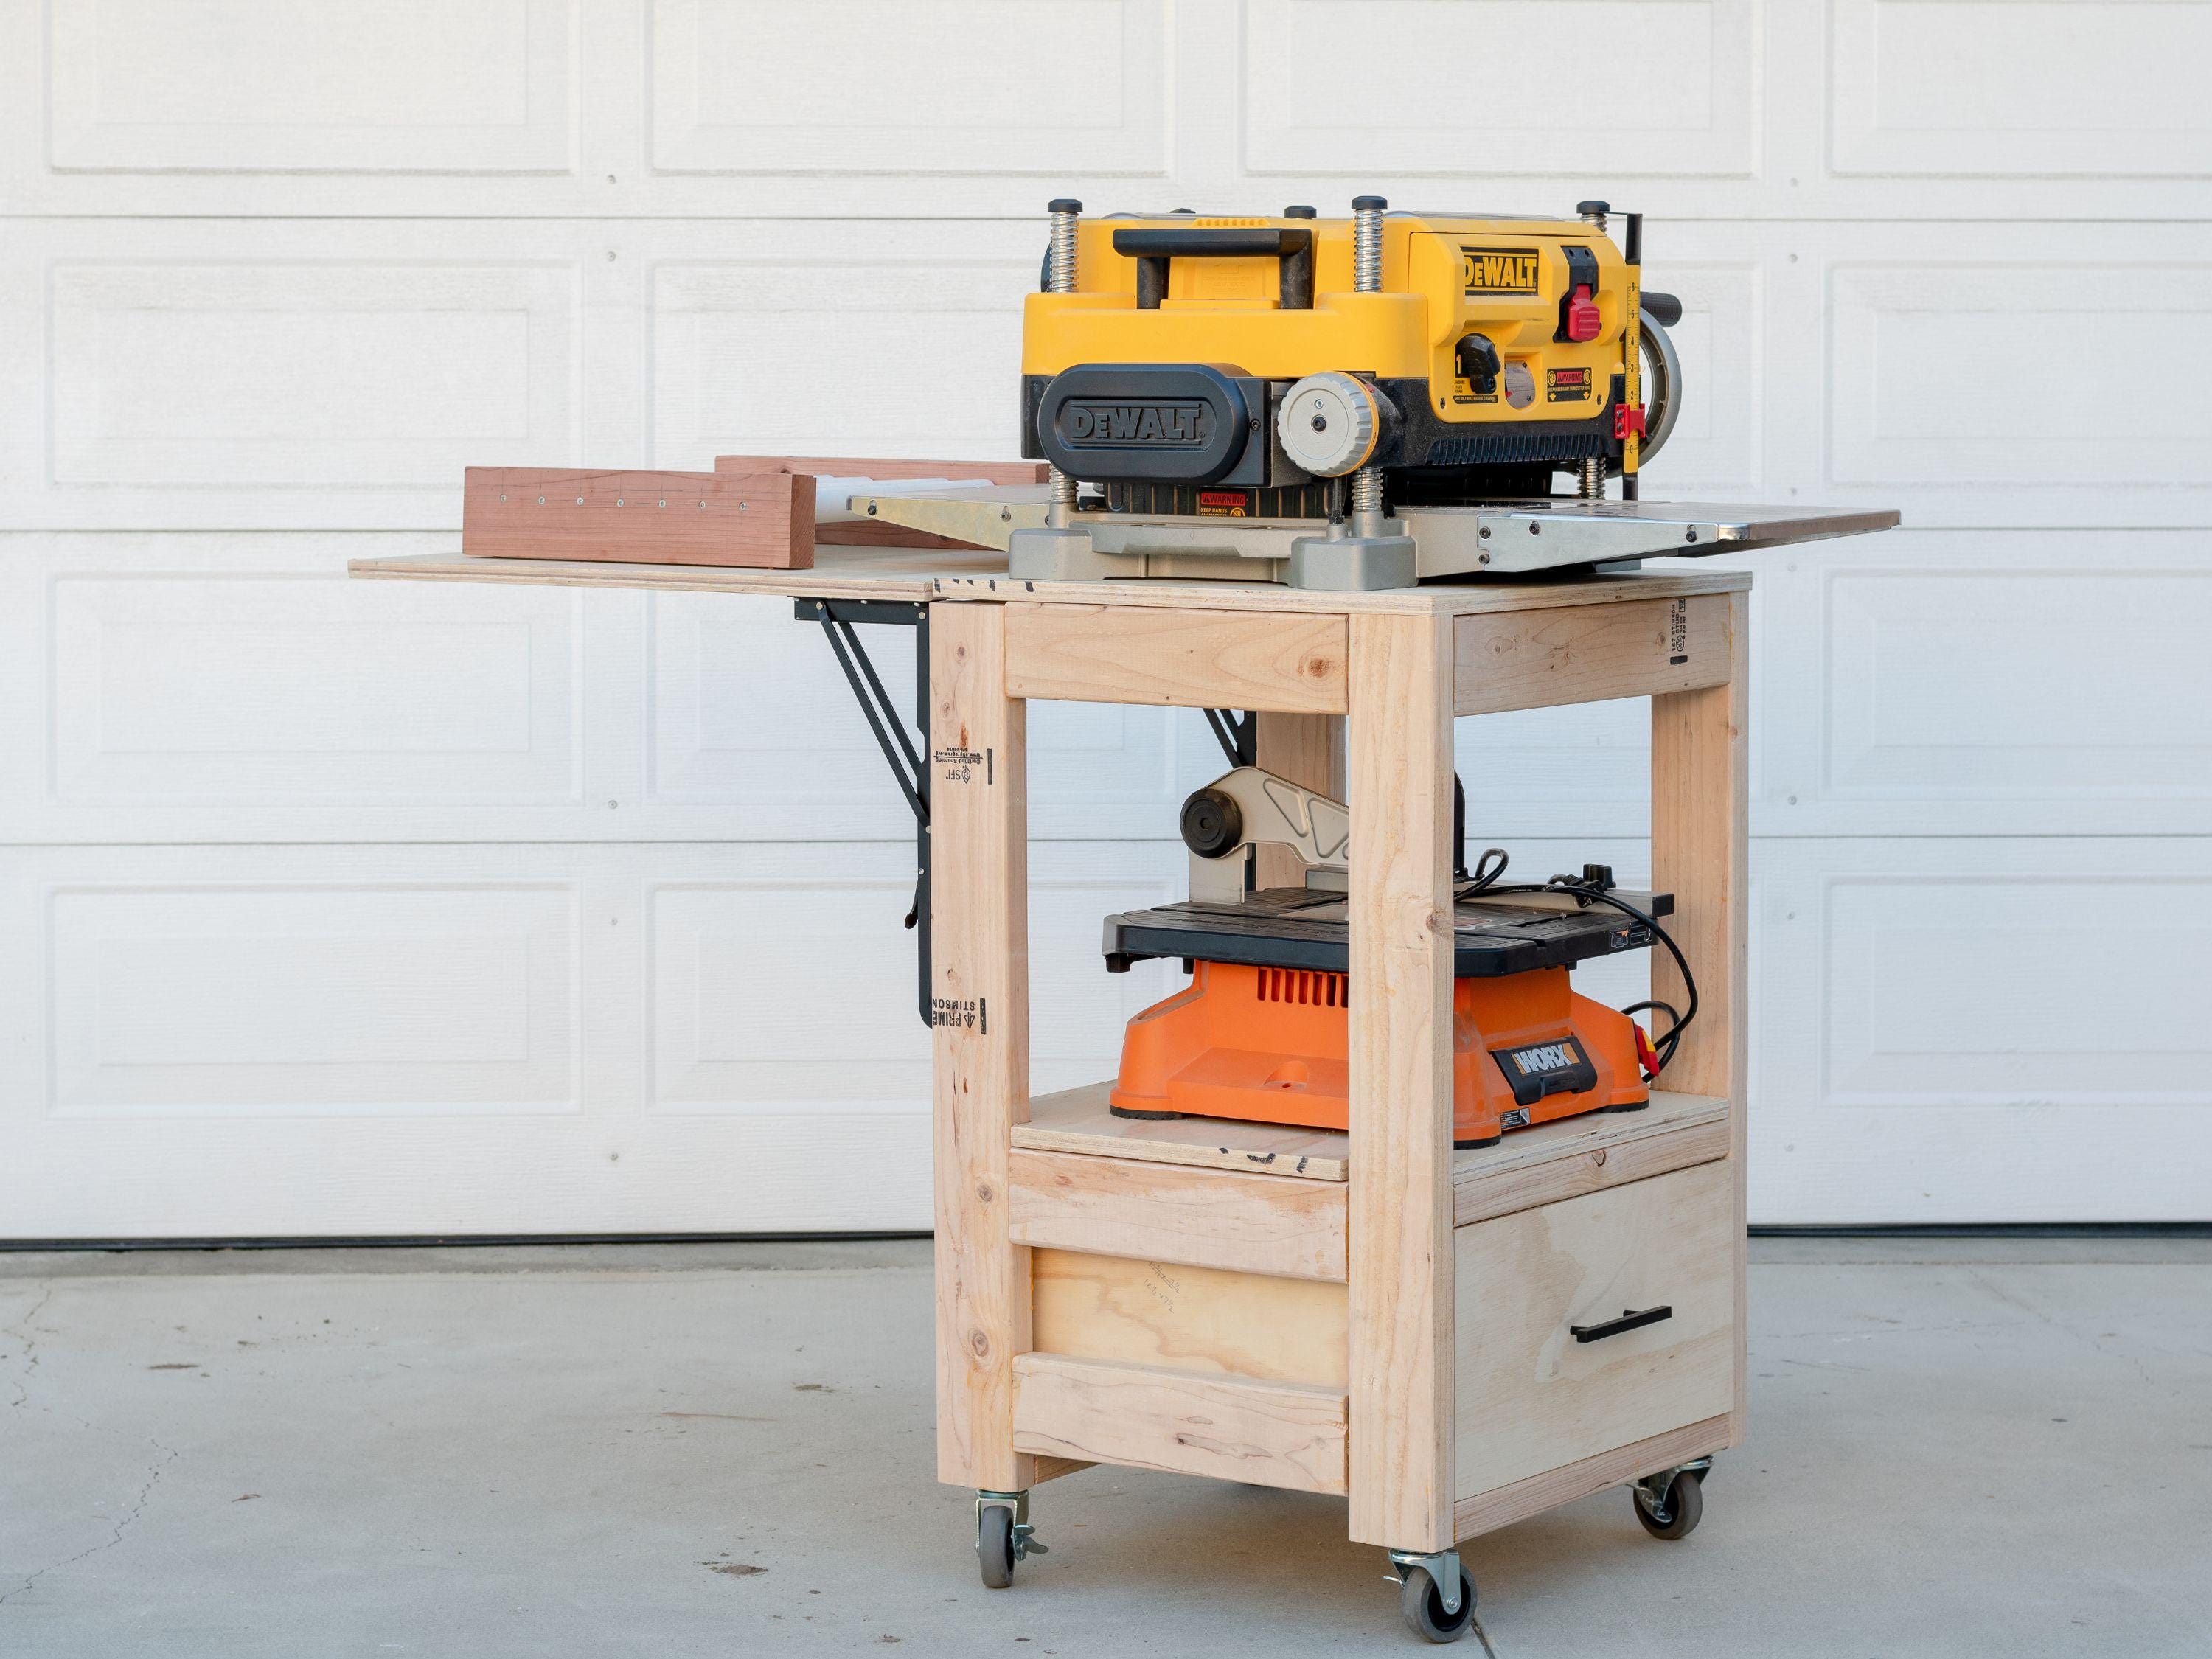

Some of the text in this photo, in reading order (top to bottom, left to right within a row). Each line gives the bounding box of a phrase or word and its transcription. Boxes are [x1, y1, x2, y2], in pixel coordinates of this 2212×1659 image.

[1464, 256, 1537, 288] DEWALT
[1630, 282, 1635, 291] 6
[1630, 310, 1635, 319] 5
[1630, 336, 1635, 345] 4
[1456, 354, 1461, 375] 1
[1630, 364, 1634, 373] 3
[1562, 372, 1582, 383] WARNING
[1630, 391, 1634, 400] 2
[1070, 408, 1202, 439] DEWALT
[1210, 495, 1244, 504] WARNING
[933, 998, 975, 1011] STIMSON
[933, 1011, 961, 1027] PRIME
[1514, 1044, 1573, 1074] WORX
